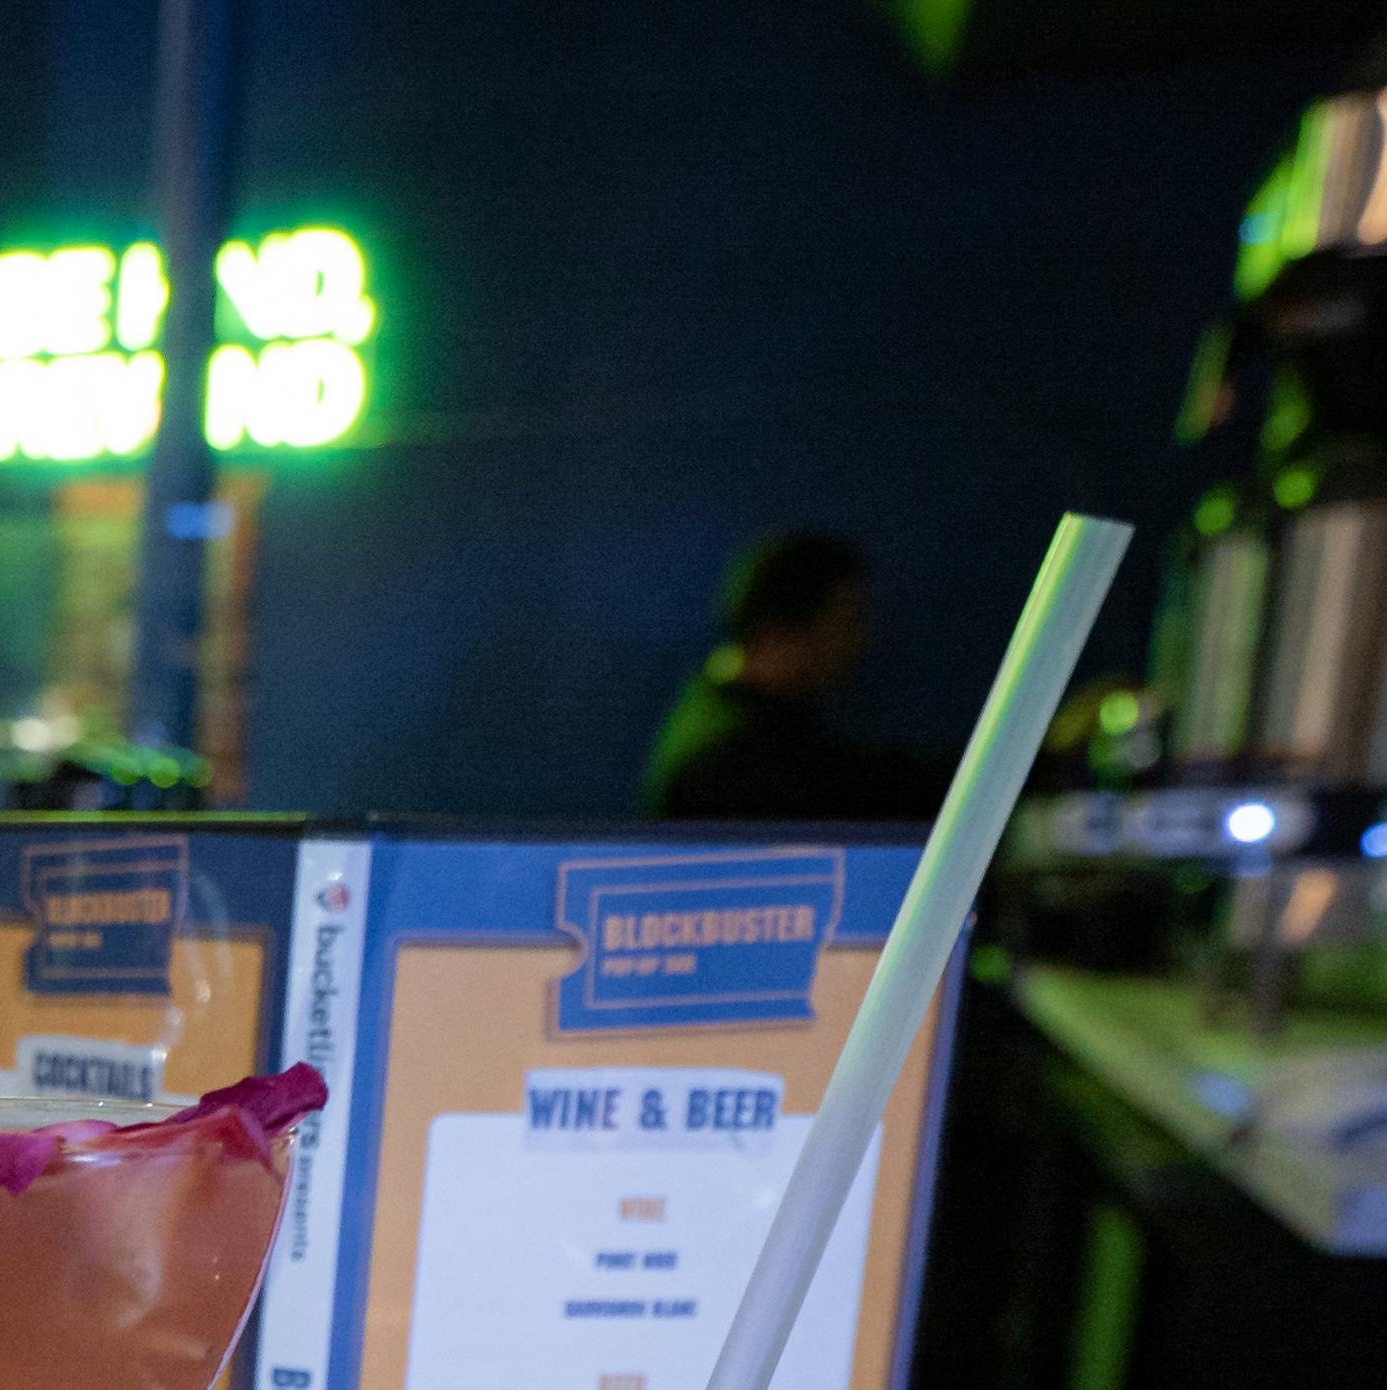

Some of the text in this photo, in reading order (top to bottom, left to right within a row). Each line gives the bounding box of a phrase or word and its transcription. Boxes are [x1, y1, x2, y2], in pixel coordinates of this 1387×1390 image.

[603, 904, 816, 952] BLOCKBUSTER
[33, 1052, 155, 1102] COCKTAILS
[529, 1088, 778, 1131] WINE & BEER
